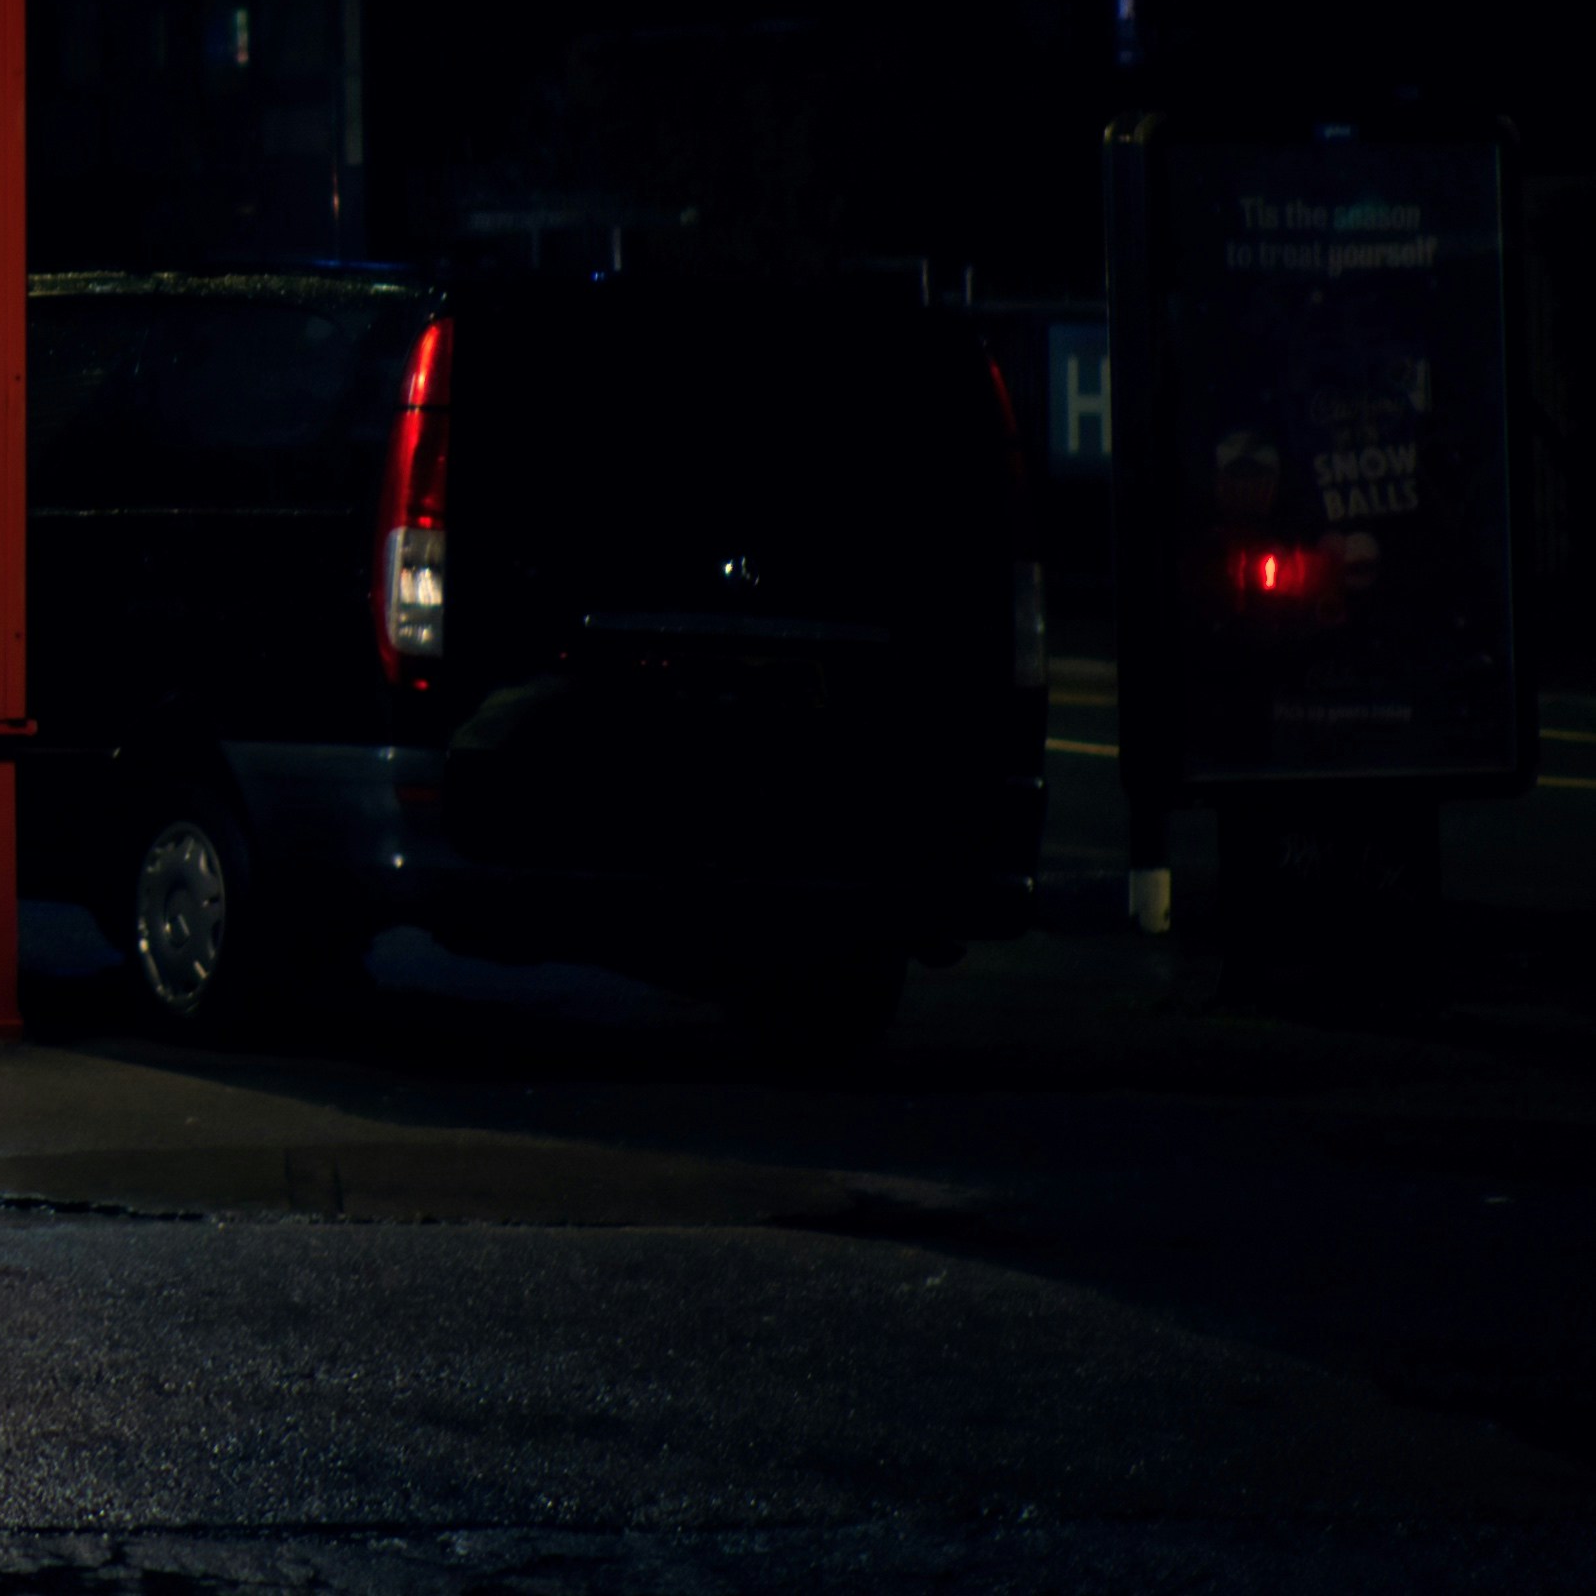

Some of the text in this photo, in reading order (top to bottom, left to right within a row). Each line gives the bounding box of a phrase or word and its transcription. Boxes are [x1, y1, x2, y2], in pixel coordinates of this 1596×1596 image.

[1333, 203, 1422, 231] season
[1225, 240, 1253, 270] to
[1327, 234, 1438, 279] yourself
[1312, 441, 1418, 487] SNOW
[1322, 477, 1420, 522] BALLS
